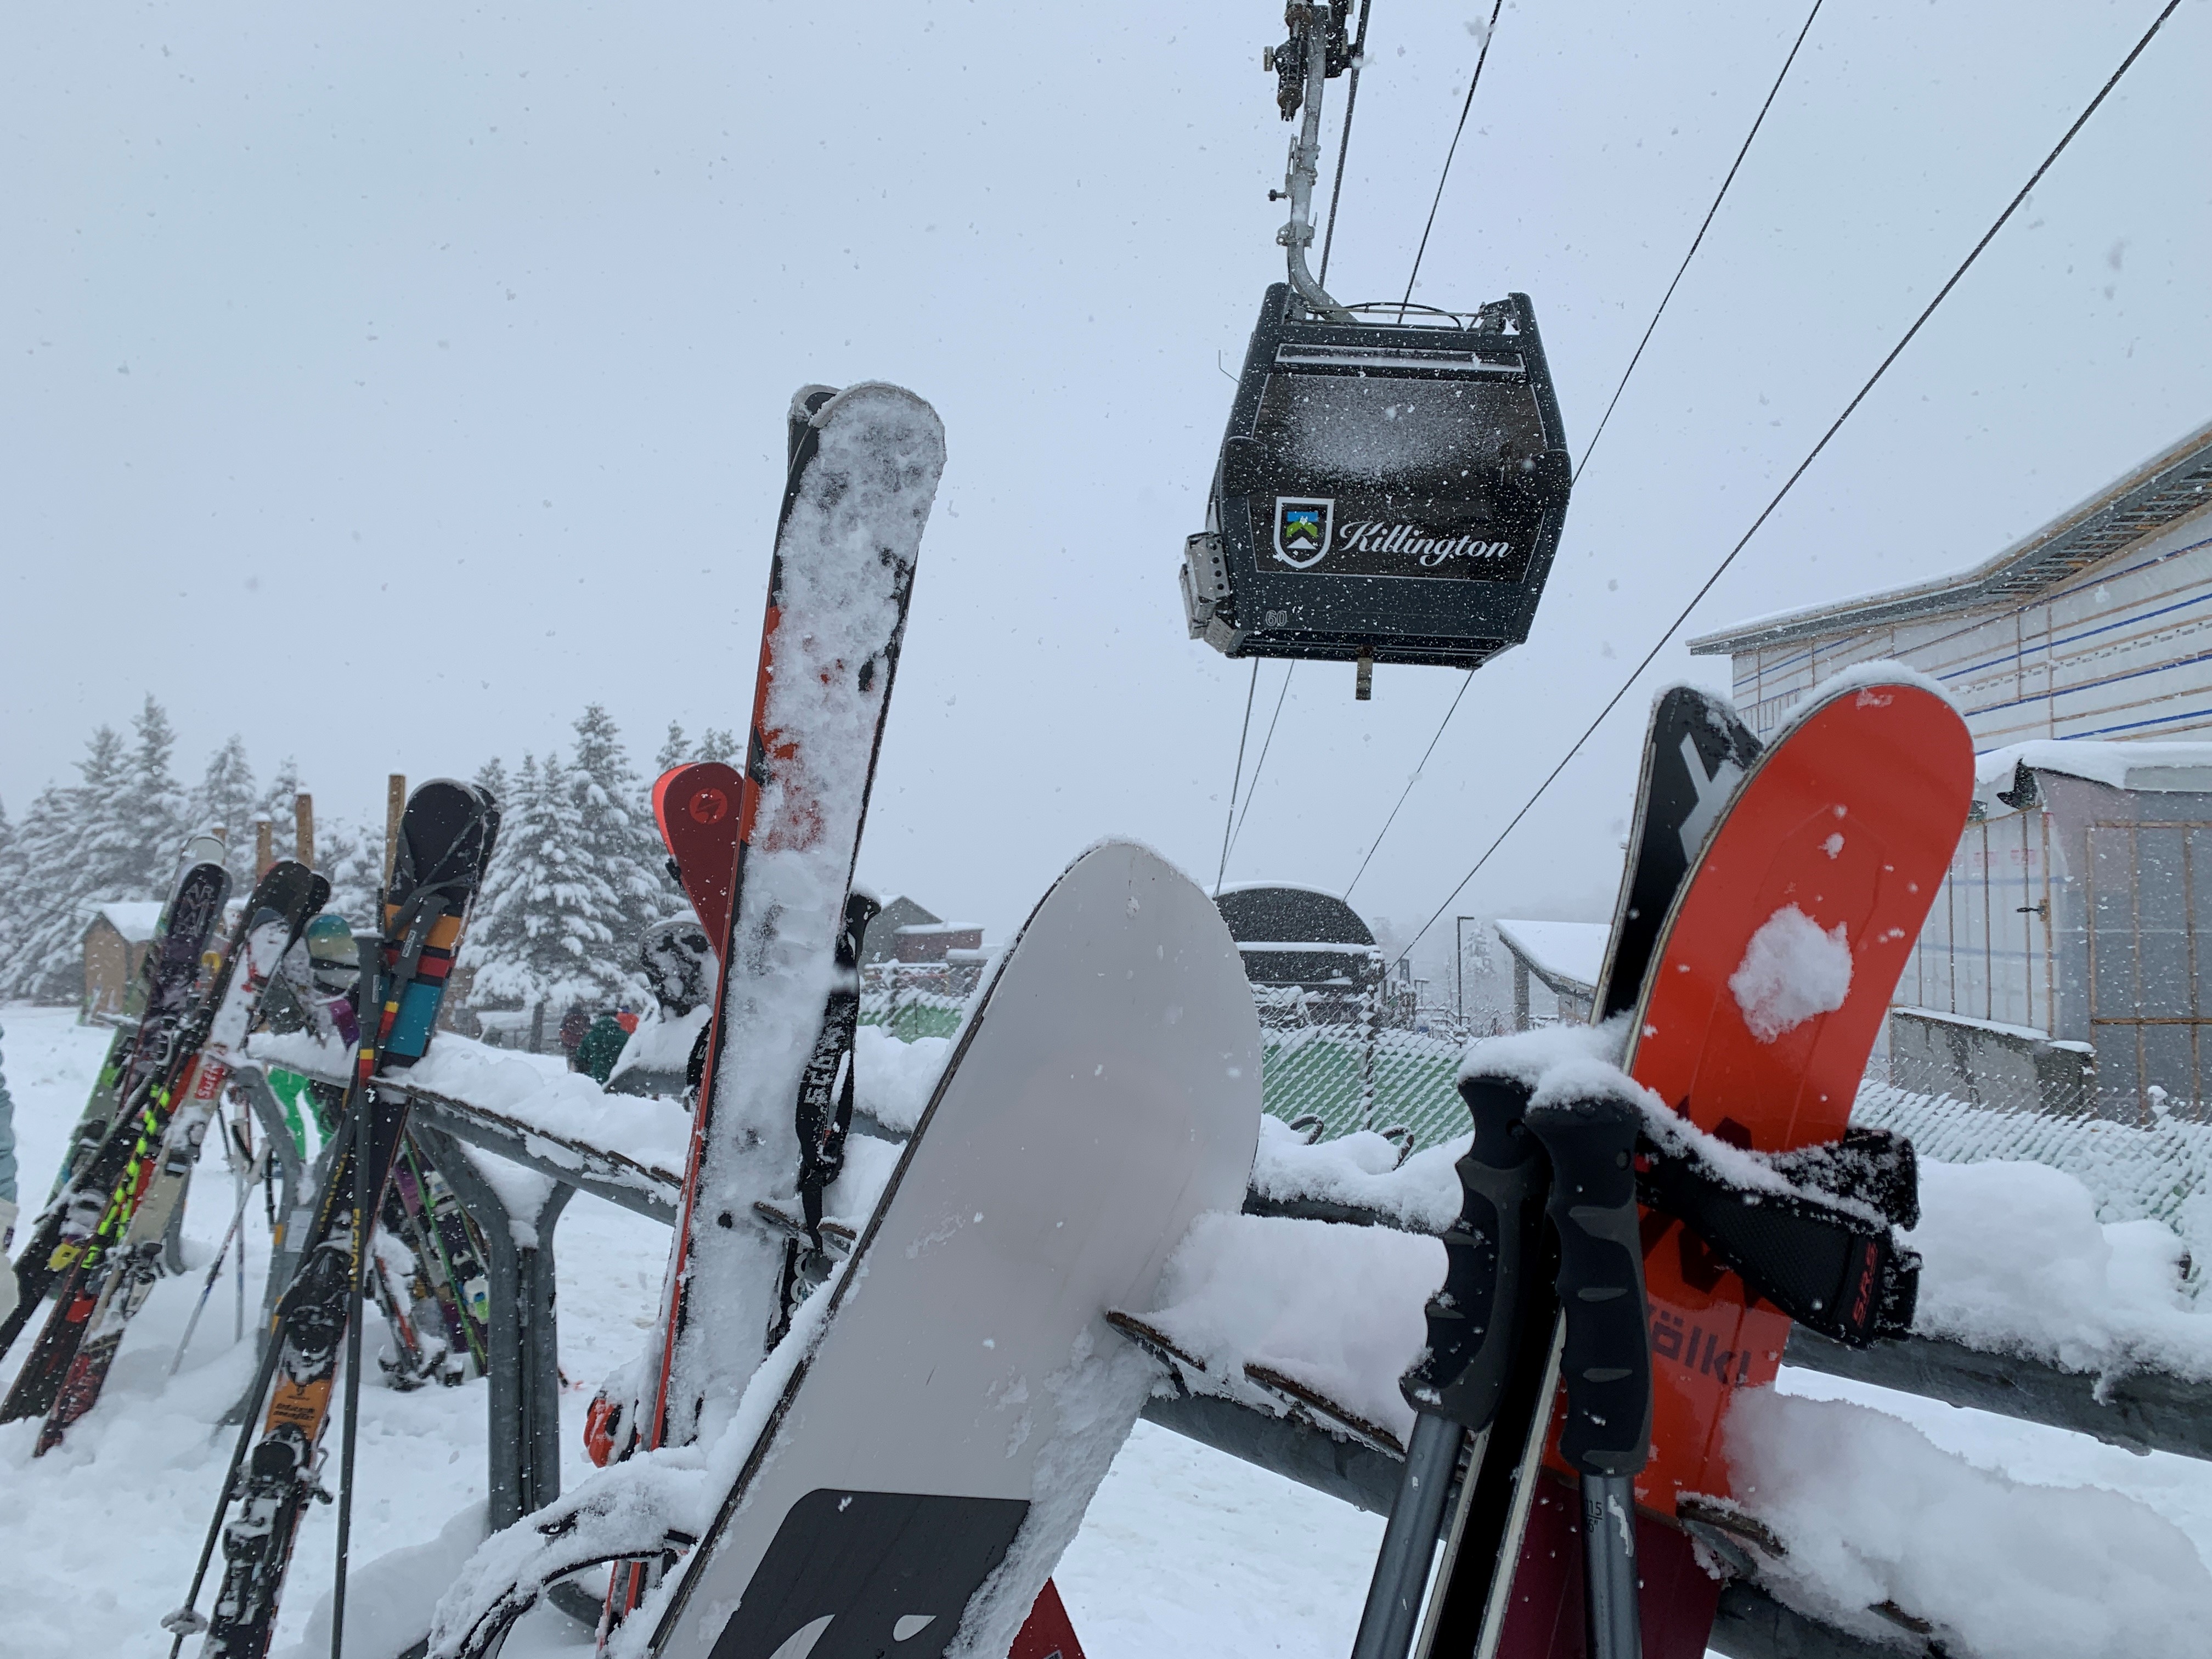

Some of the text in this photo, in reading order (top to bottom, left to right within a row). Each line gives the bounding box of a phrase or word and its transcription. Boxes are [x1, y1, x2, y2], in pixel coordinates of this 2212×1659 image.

[1339, 521, 1515, 567] Killington
[1265, 609, 1288, 627] 60
[1647, 1303, 1753, 1387] ölkl
